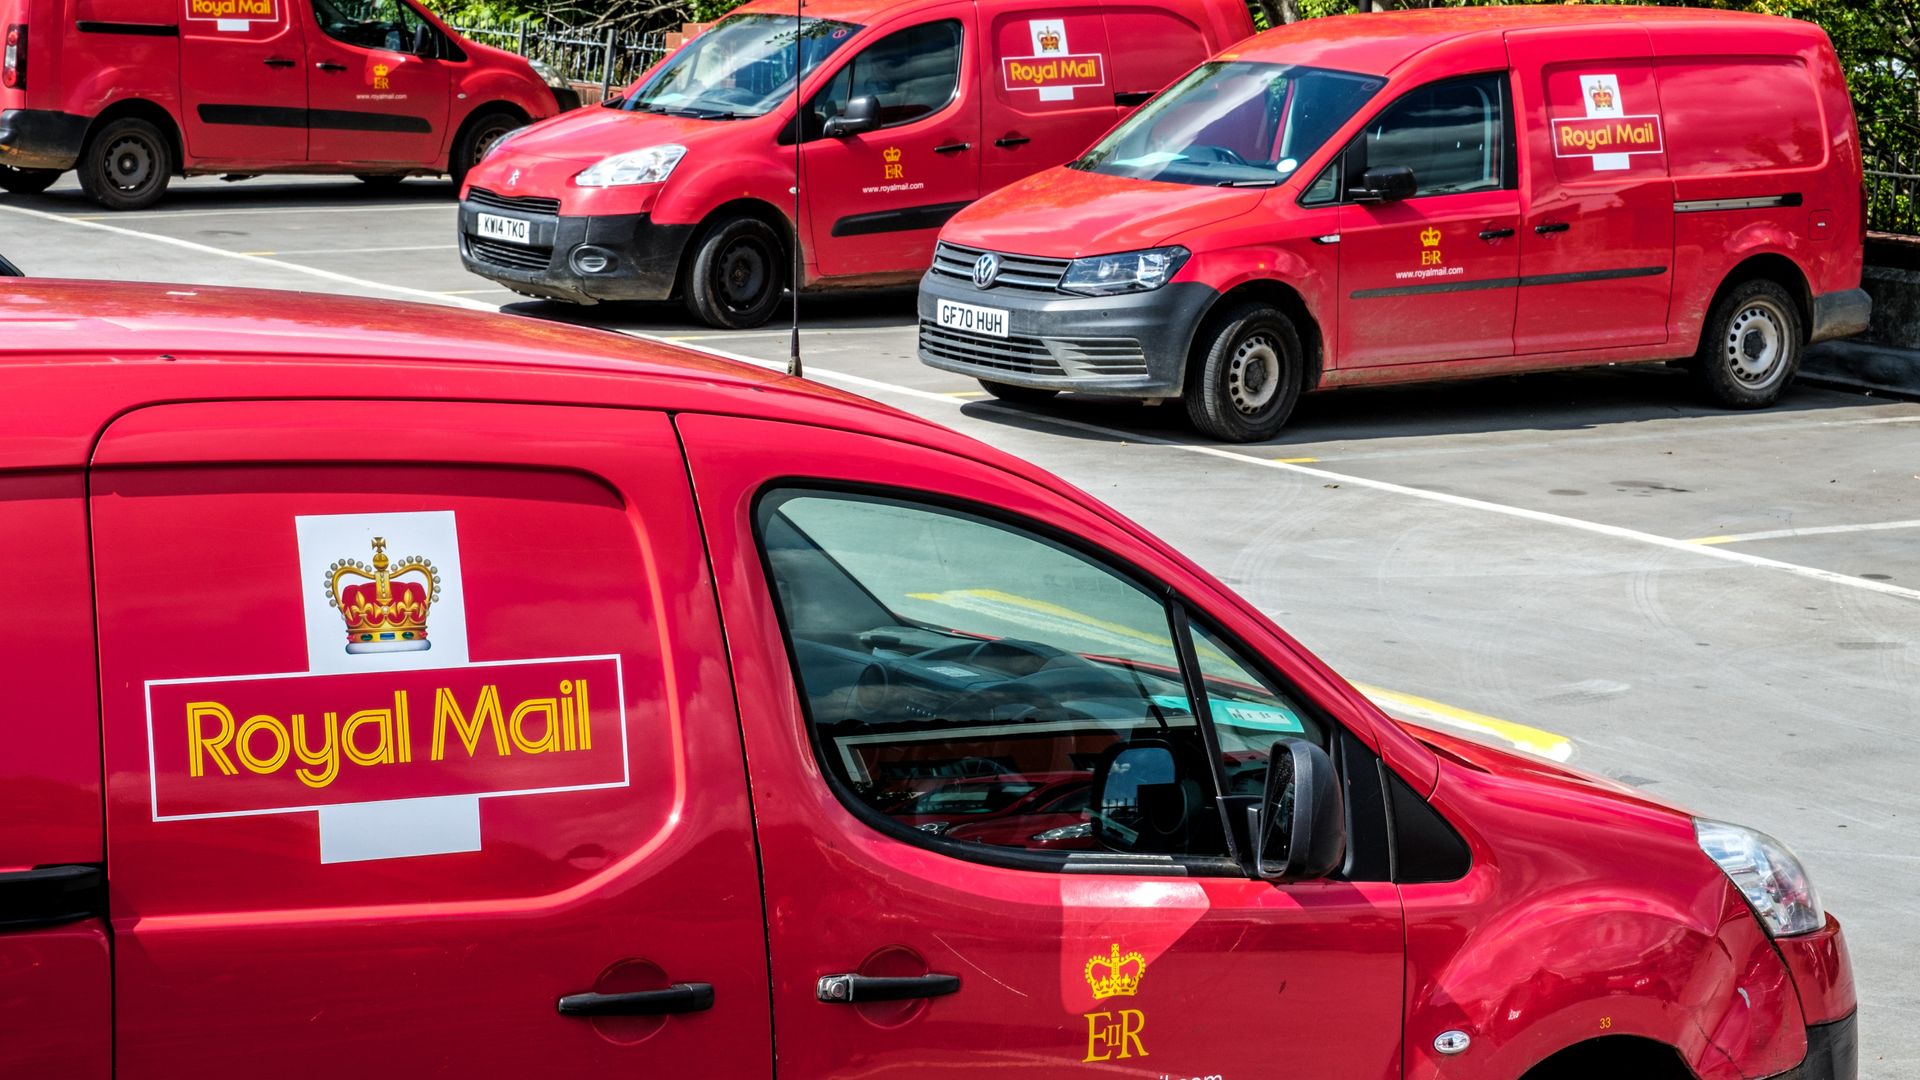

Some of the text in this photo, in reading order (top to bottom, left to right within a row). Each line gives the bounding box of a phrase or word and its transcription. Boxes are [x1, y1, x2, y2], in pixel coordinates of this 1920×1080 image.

[192, 0, 271, 17] Royal Mail
[1010, 59, 1096, 84] Royal Mail
[1560, 122, 1655, 151] Royal Mail
[862, 182, 924, 194] www.royalmail.com
[484, 216, 525, 239] KW14 TKO
[1395, 266, 1464, 280] www.royalmail.com
[943, 305, 1002, 334] GF70 HUH
[186, 679, 592, 789] Royal Mail
[1600, 1016, 1611, 1029] 33
